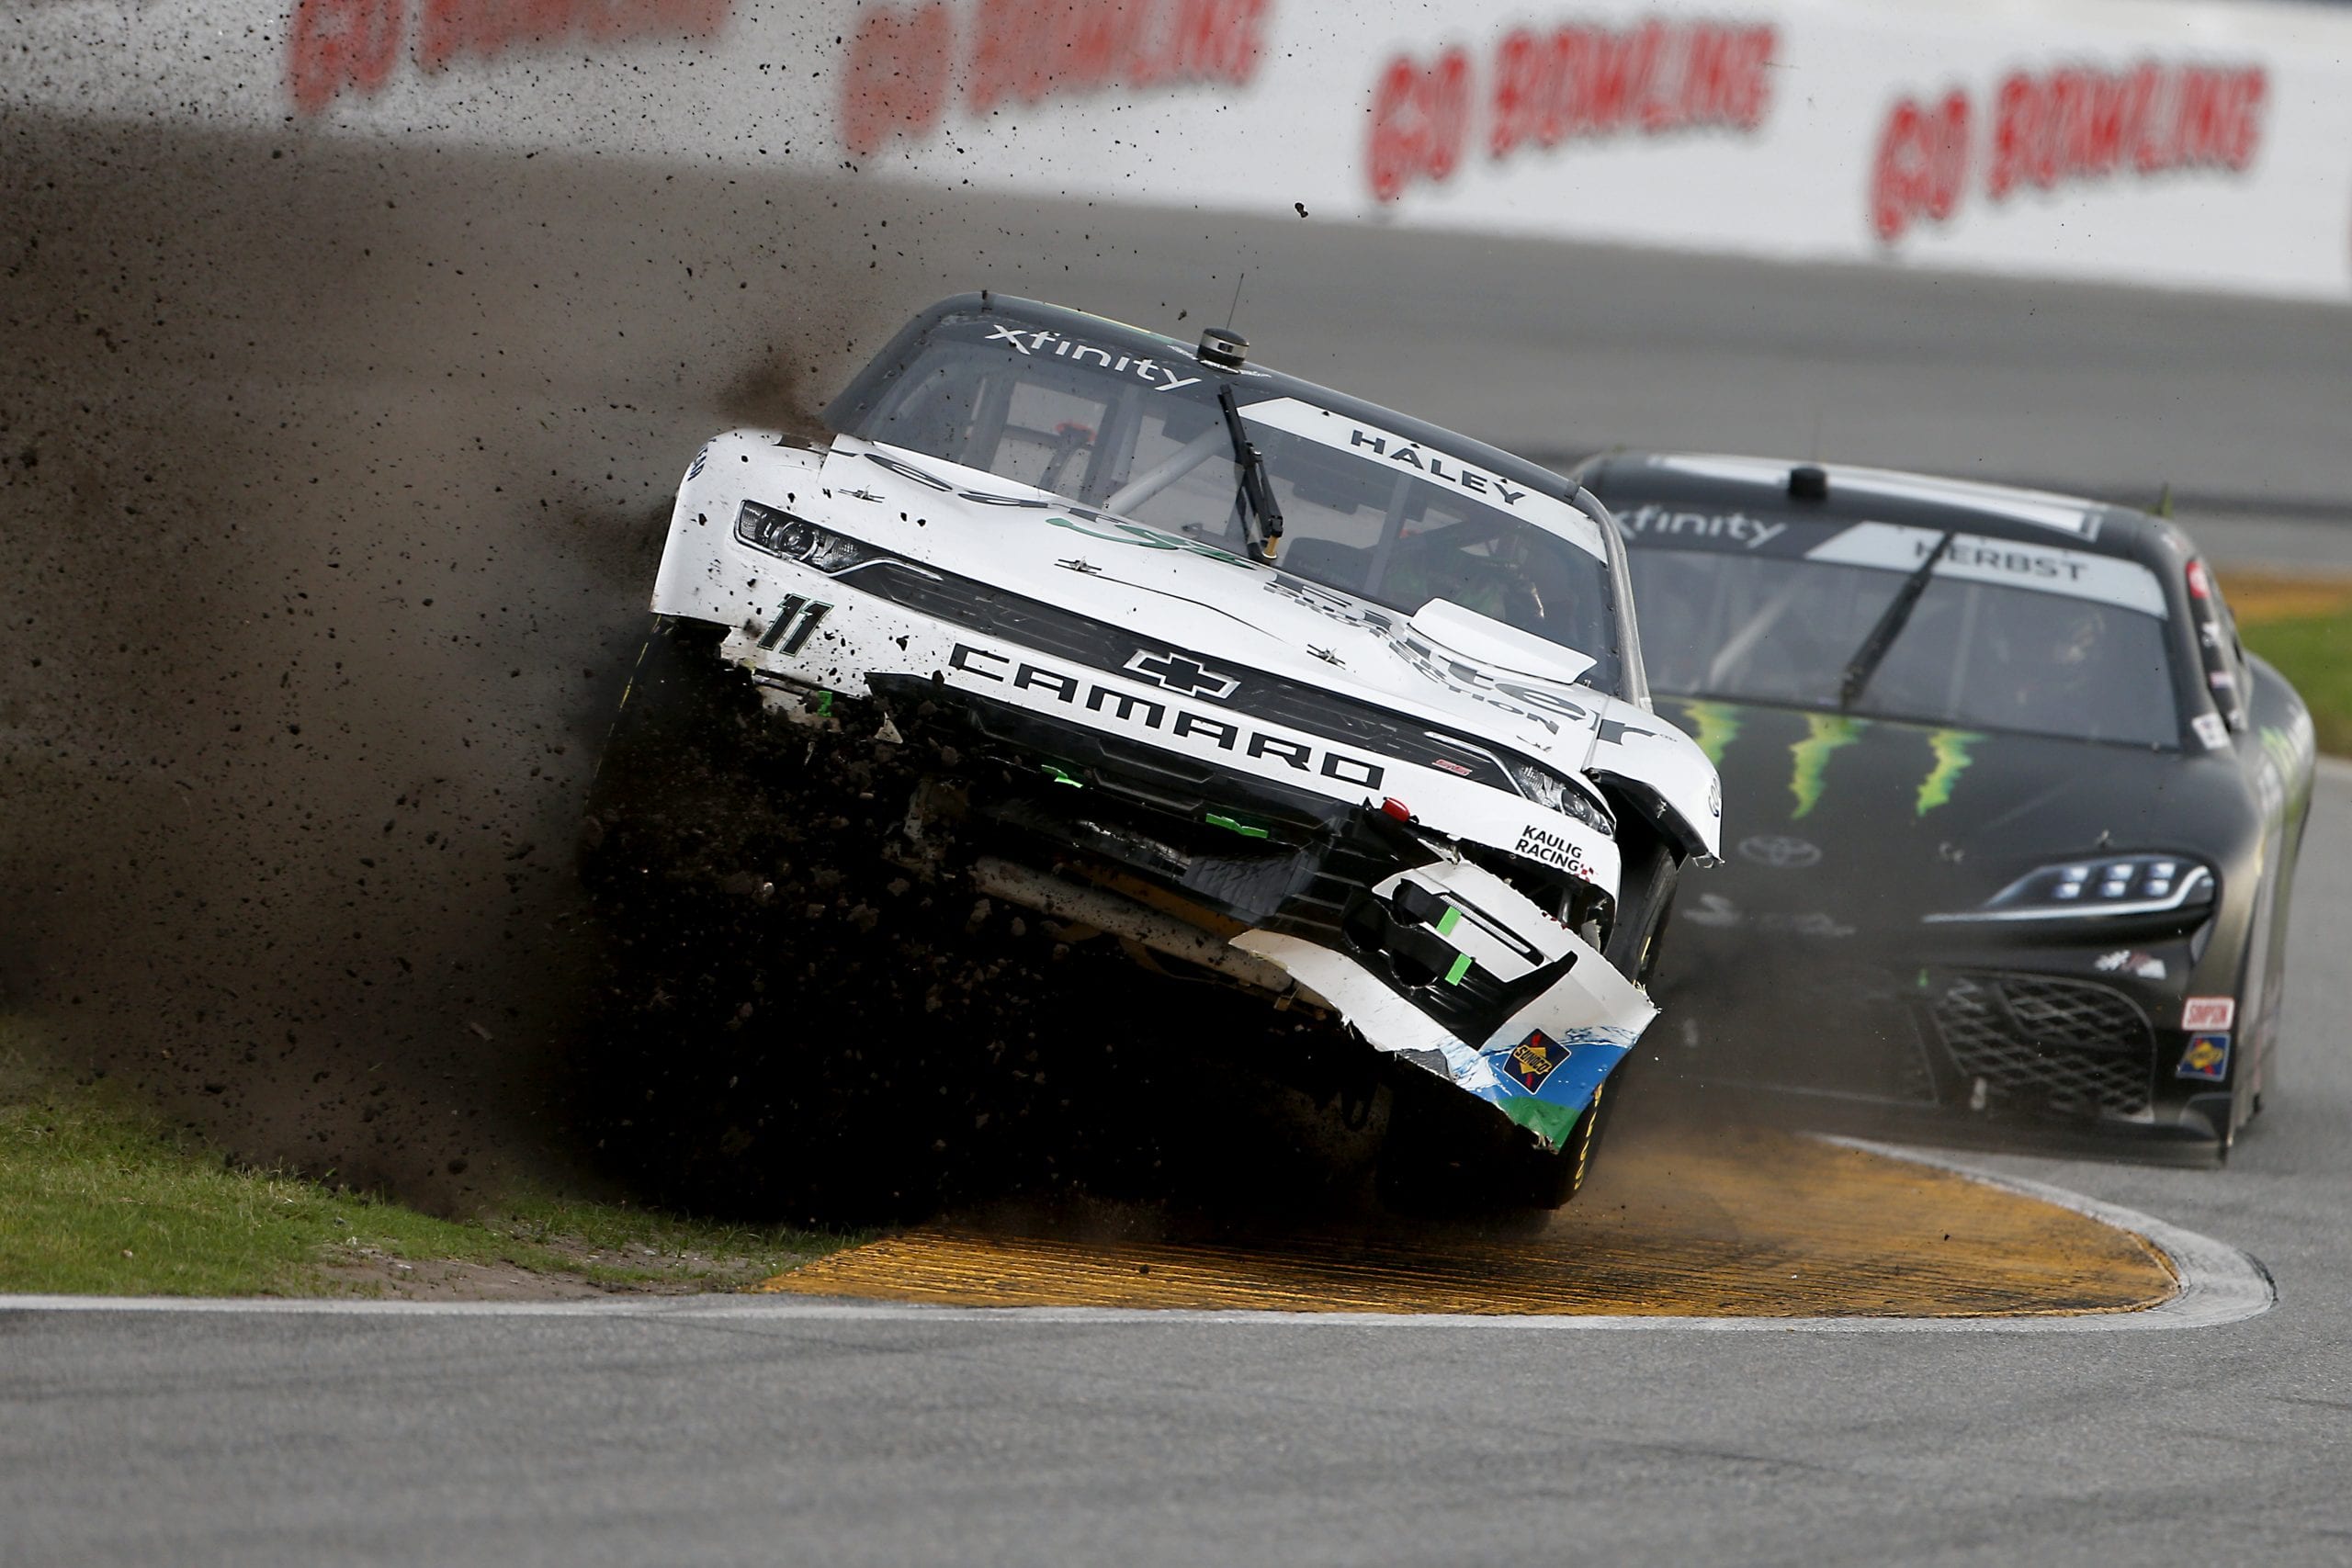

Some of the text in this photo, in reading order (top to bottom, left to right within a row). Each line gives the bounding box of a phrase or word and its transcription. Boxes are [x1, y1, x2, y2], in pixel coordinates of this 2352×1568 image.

[985, 324, 1203, 391] xfinity
[1351, 429, 1527, 505] HALEY
[757, 592, 834, 657] 11
[948, 643, 1385, 791] CAMARO
[1514, 839, 1580, 872] RACING
[1522, 825, 1582, 859] KAULIG
[1514, 1045, 1551, 1073] SUNOCO
